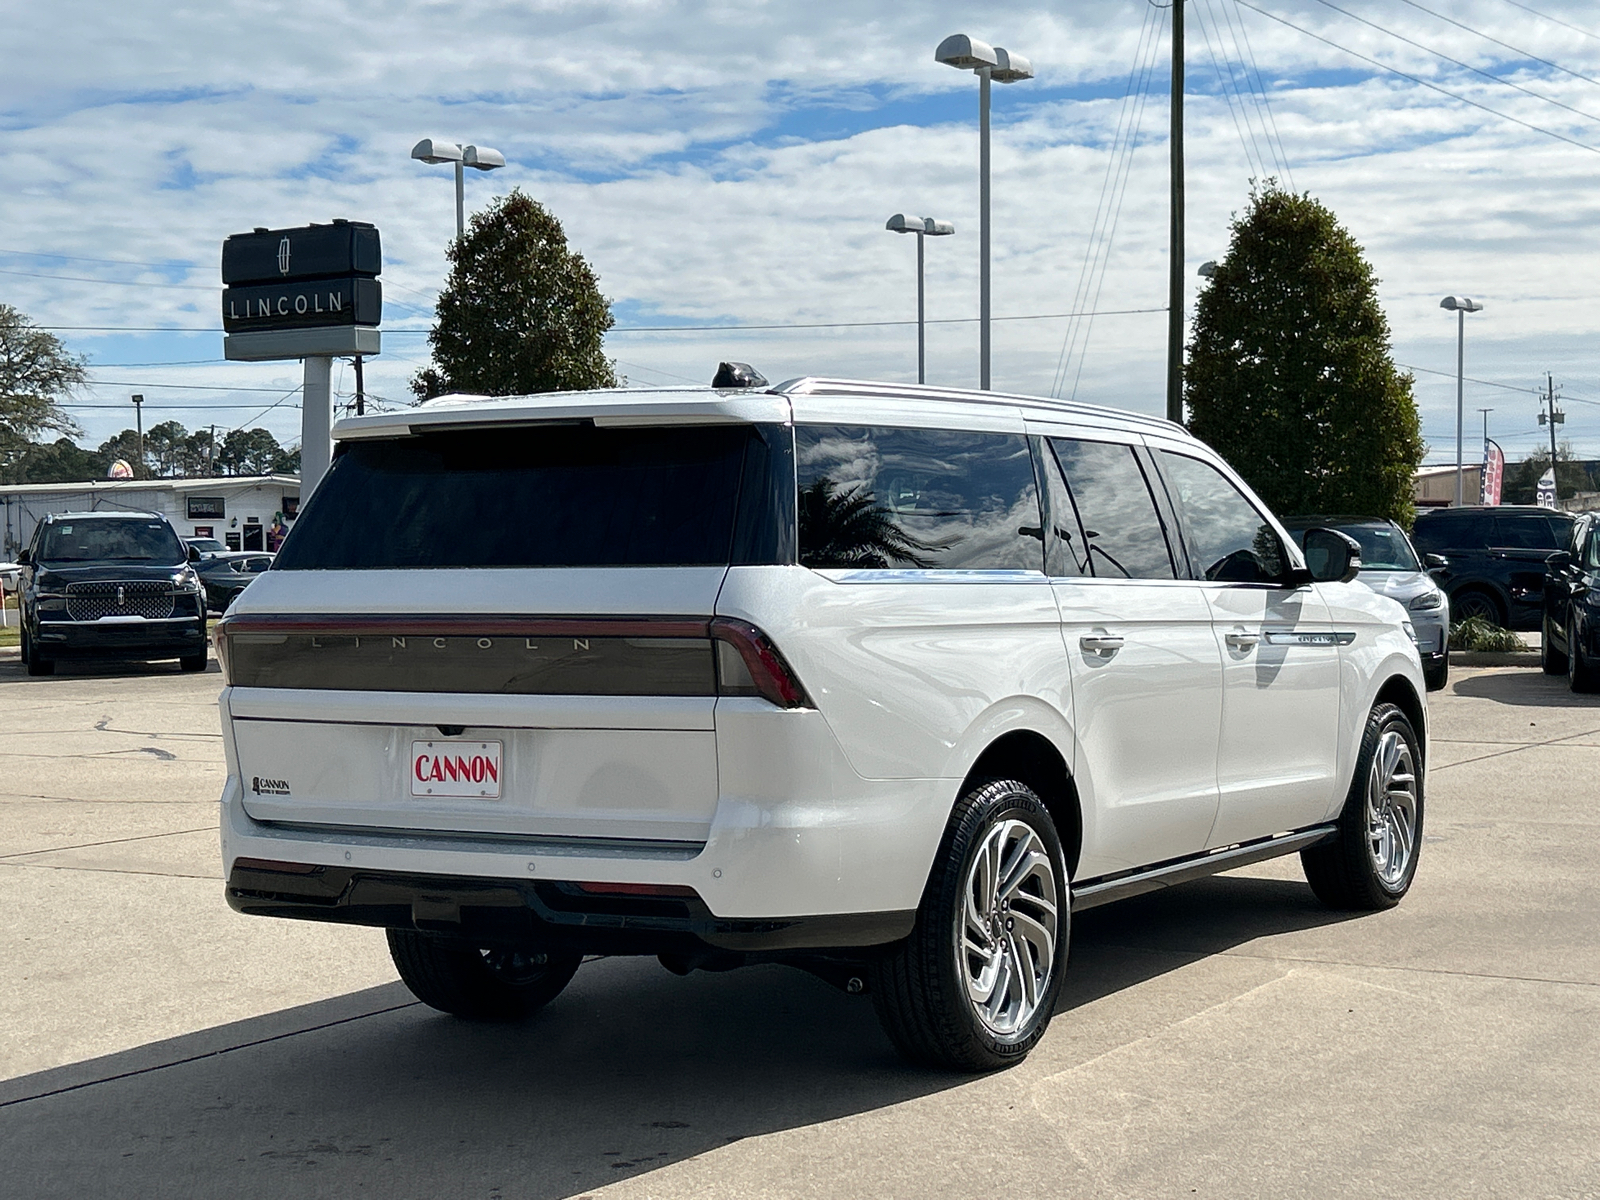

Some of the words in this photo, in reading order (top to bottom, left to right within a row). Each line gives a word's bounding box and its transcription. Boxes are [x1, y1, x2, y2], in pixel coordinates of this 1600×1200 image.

[230, 291, 342, 319] LINCOLN
[312, 637, 589, 650] LINCOLN
[415, 755, 498, 783] CANNON
[260, 778, 289, 789] CANNON
